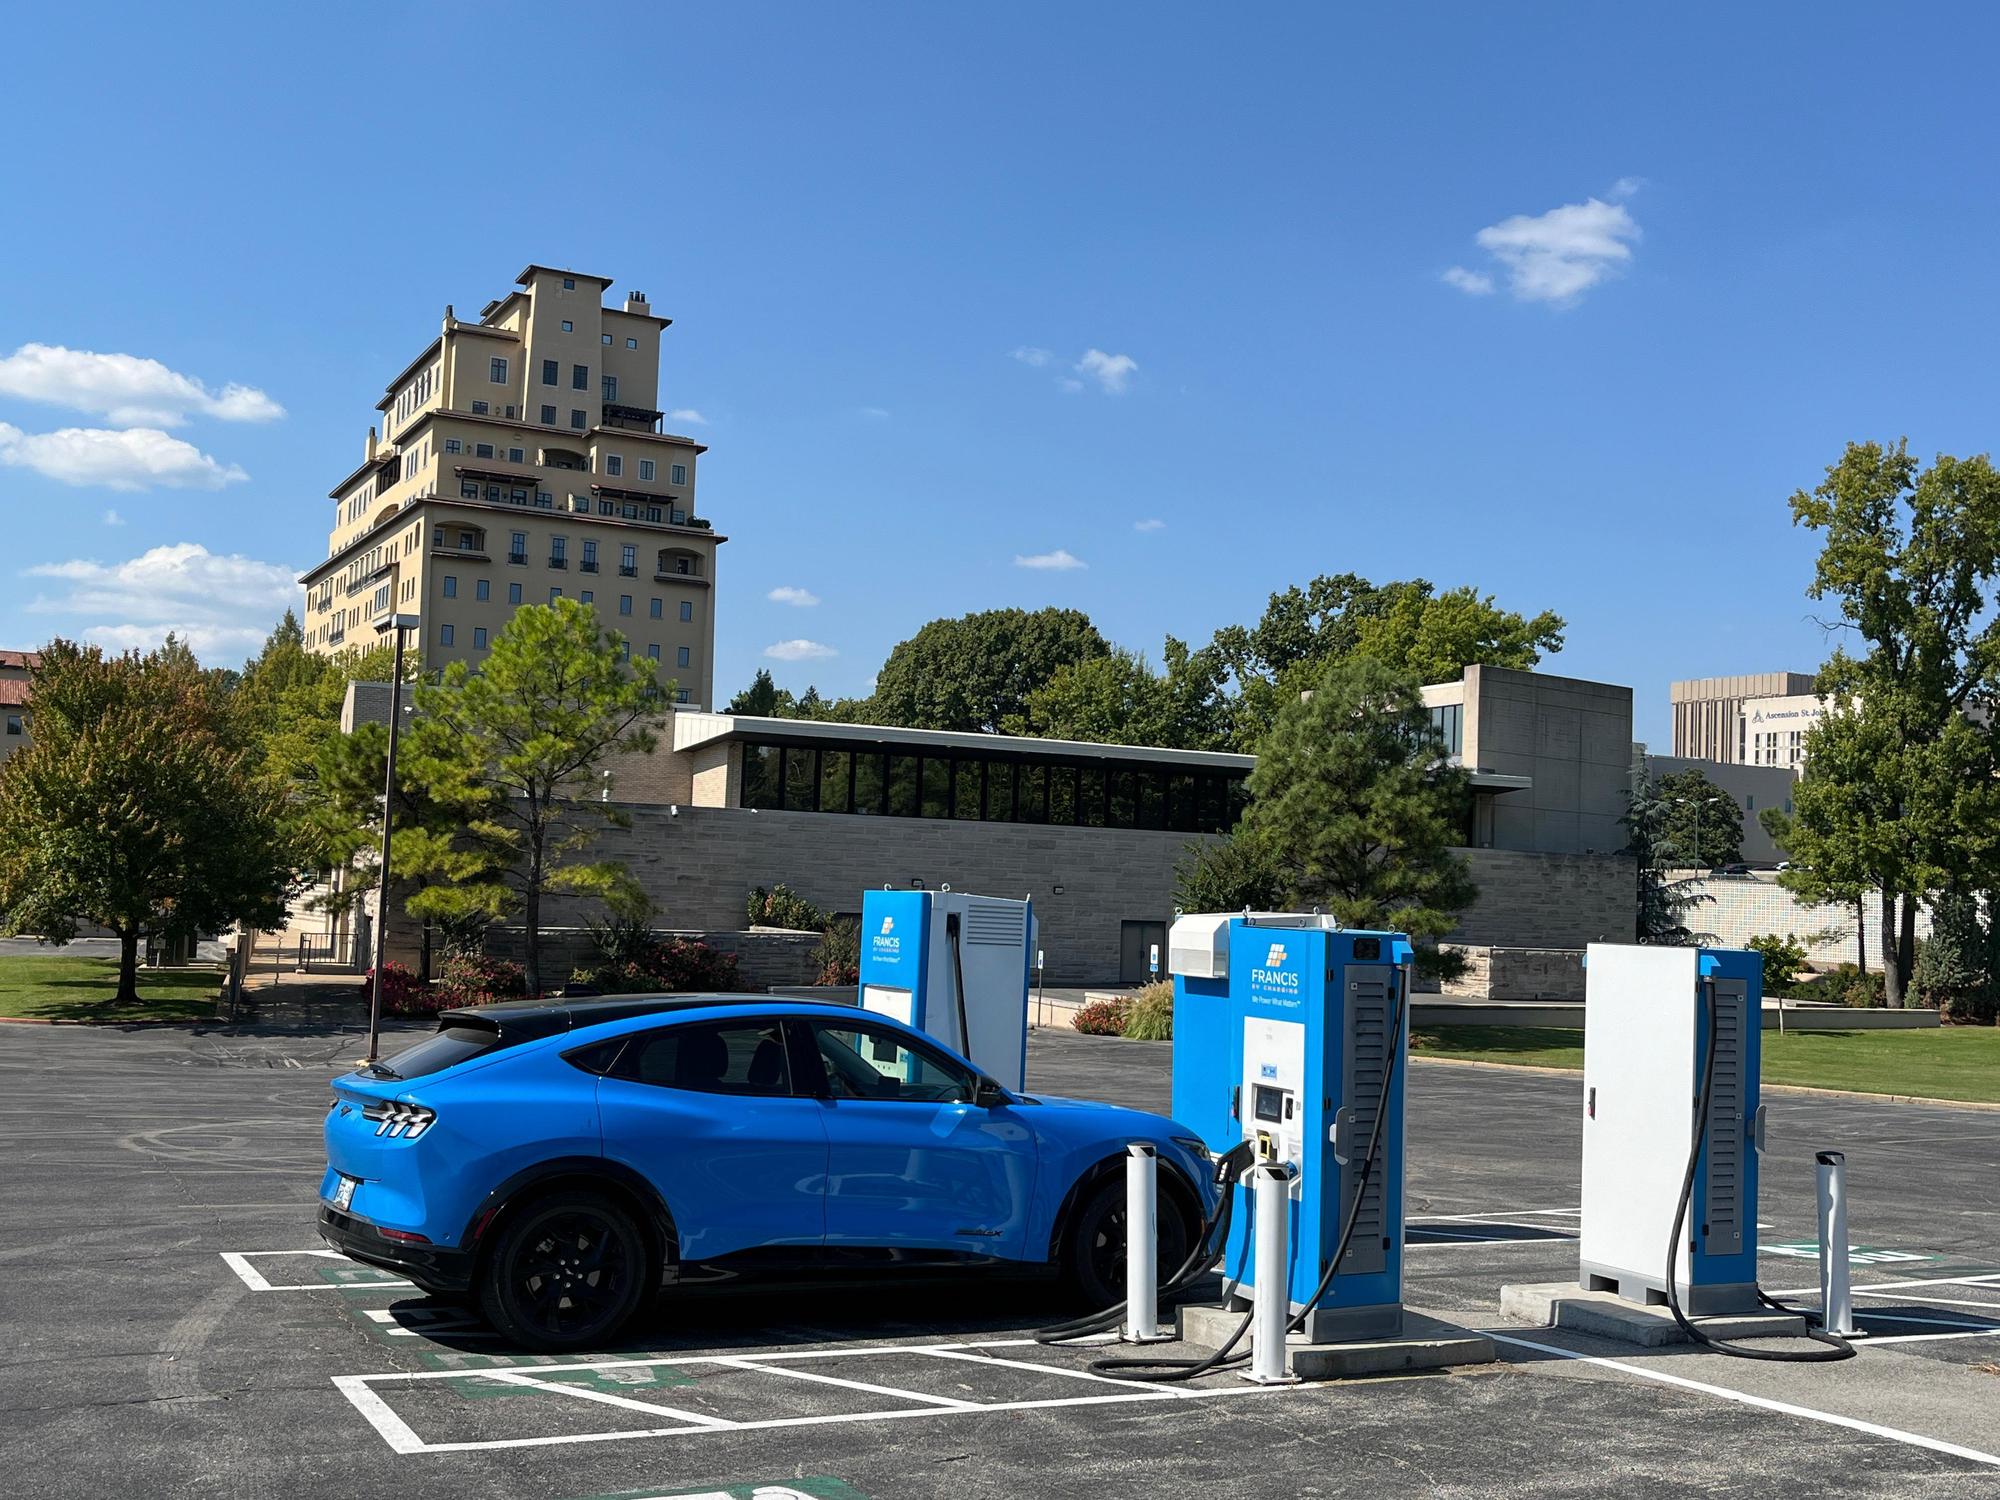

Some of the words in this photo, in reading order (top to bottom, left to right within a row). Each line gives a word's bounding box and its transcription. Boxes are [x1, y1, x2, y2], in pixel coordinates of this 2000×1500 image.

[1765, 710, 1799, 719] Ascension
[873, 936, 900, 947] FRANCIS
[1252, 969, 1298, 987] FRANCIS
